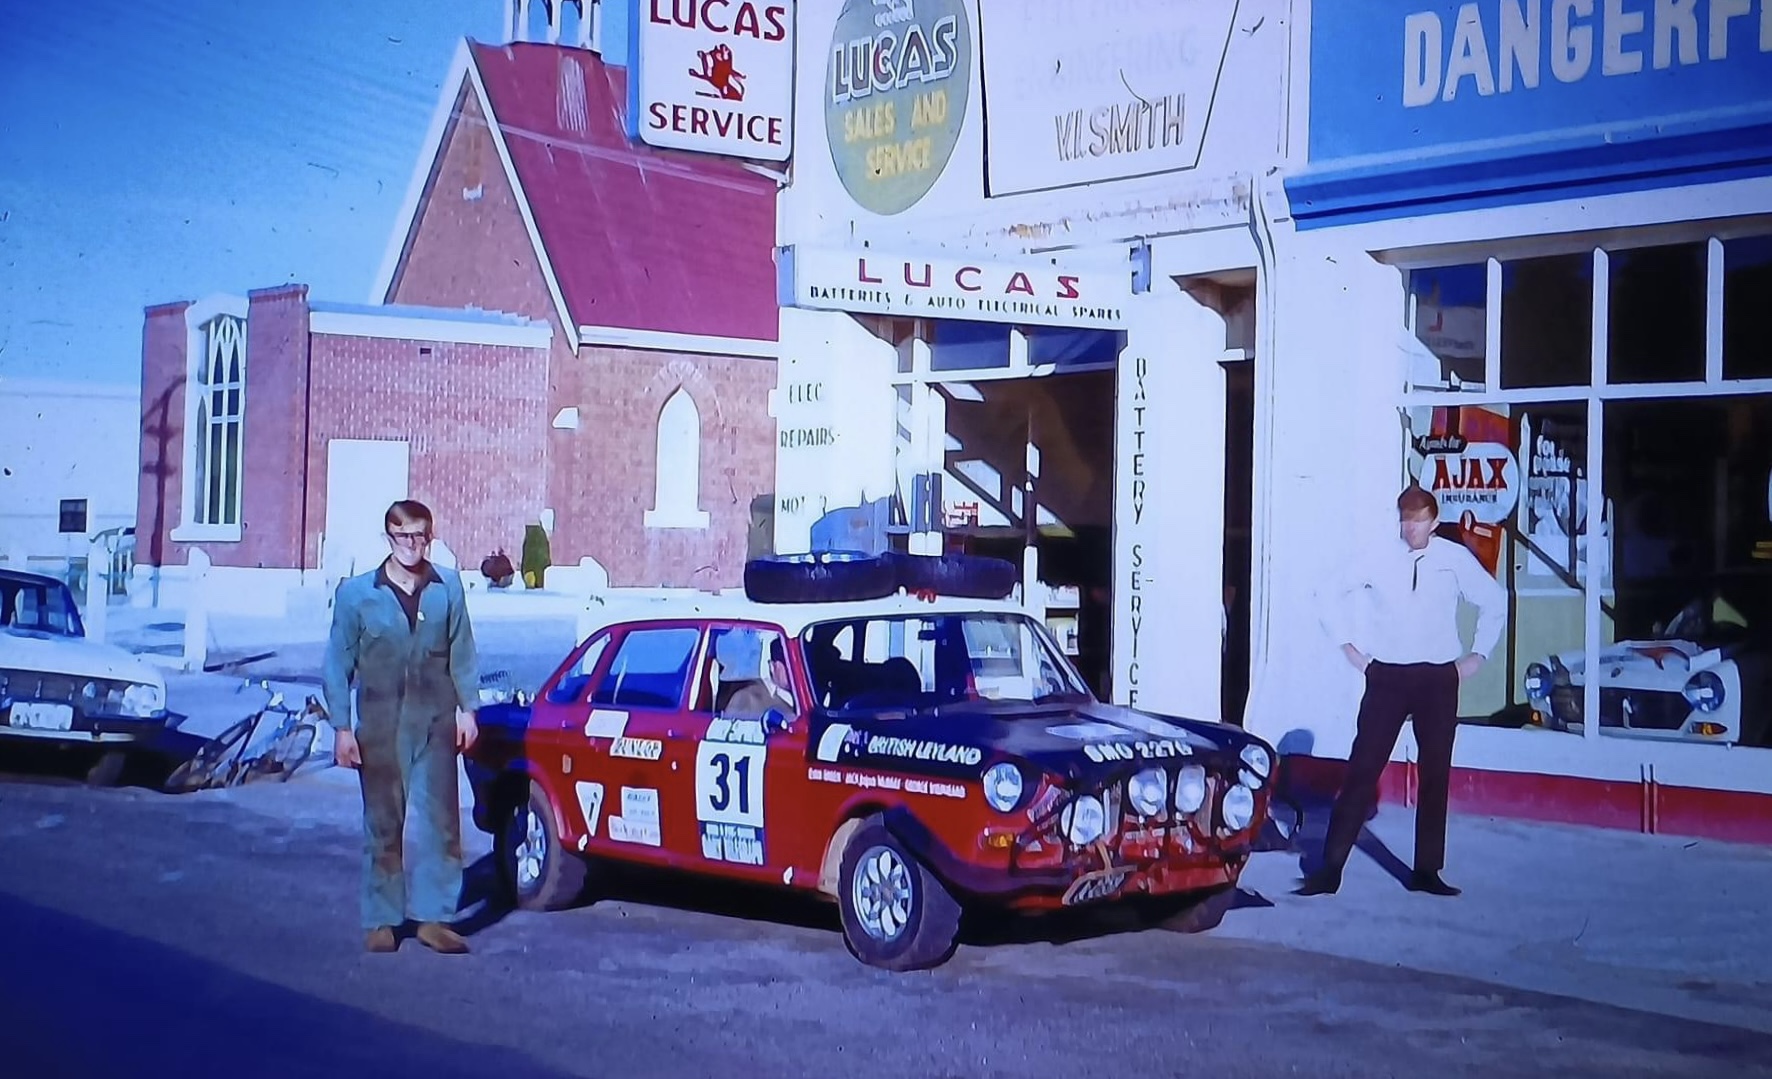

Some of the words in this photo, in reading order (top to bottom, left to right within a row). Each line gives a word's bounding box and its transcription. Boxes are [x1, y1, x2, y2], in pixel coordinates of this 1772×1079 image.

[650, 0, 785, 41] LUCAS
[832, 15, 958, 104] LUCAS
[649, 102, 782, 145] SERVICE
[844, 101, 896, 143] SALES
[911, 91, 948, 129] AND
[866, 137, 932, 180] SERVICE
[858, 258, 1079, 299] LUCAS
[810, 285, 890, 305] BATTERIES
[928, 295, 965, 309] AUTO
[978, 300, 1058, 317] ELECTRICAL
[1072, 306, 1121, 320] SPARES
[780, 428, 836, 448] REPAIRS
[1134, 358, 1147, 525] BATTERY
[1432, 457, 1508, 490] AJAX
[1442, 491, 1497, 504] INSURANCE
[1129, 544, 1142, 709] SERVICE
[868, 735, 917, 759] BRITISH
[916, 740, 982, 765] LEYLAND
[709, 753, 750, 814] 31
